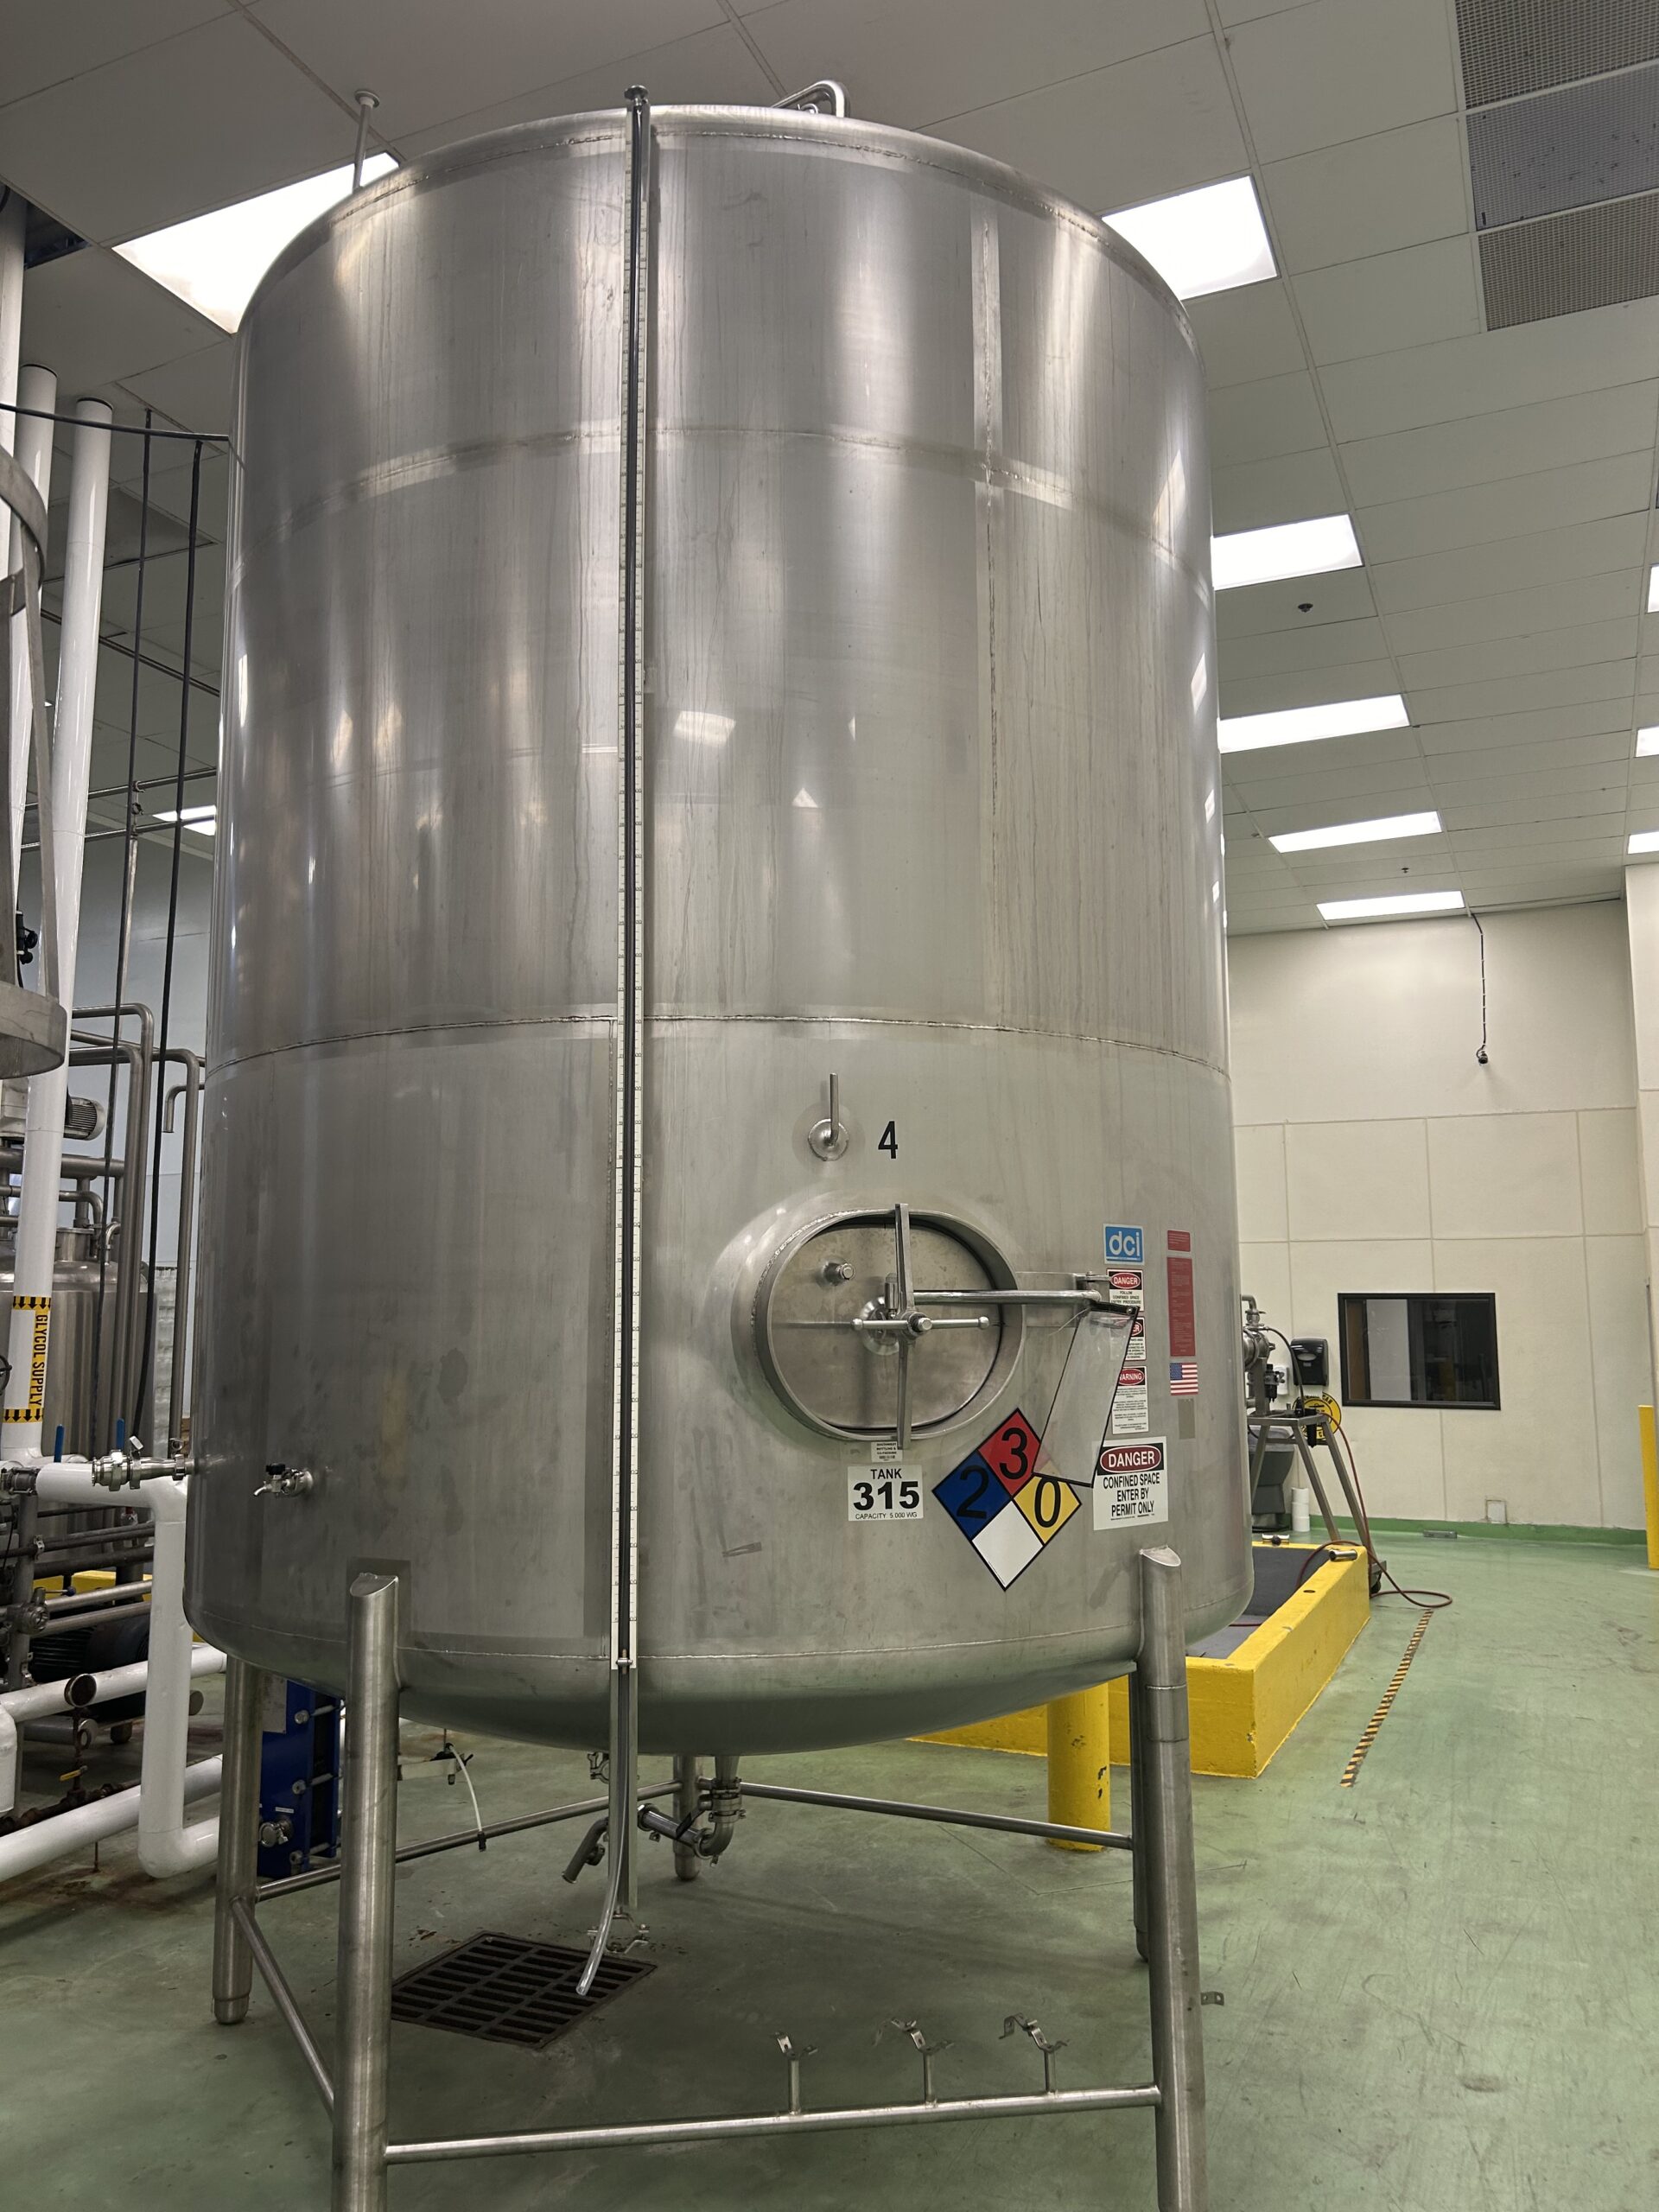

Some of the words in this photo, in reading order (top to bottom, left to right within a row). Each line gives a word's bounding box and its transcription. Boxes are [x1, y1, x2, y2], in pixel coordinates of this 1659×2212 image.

[878, 1121, 899, 1159] 4
[1109, 1231, 1140, 1257] dci
[33, 1314, 48, 1358] GLYCOL
[29, 1361, 45, 1406] SUPPLY
[1000, 1427, 1028, 1479] 3
[1109, 1451, 1155, 1468] DANGER
[870, 1468, 902, 1480] TANK
[1103, 1474, 1139, 1490] CONFINED
[1139, 1471, 1160, 1486] SPACE
[853, 1481, 920, 1511] 315
[957, 1465, 989, 1519] 2
[1116, 1488, 1140, 1503] ENTER
[1141, 1486, 1149, 1500] BY
[1111, 1503, 1137, 1517] PERMIT
[1137, 1500, 1155, 1514] ONLY
